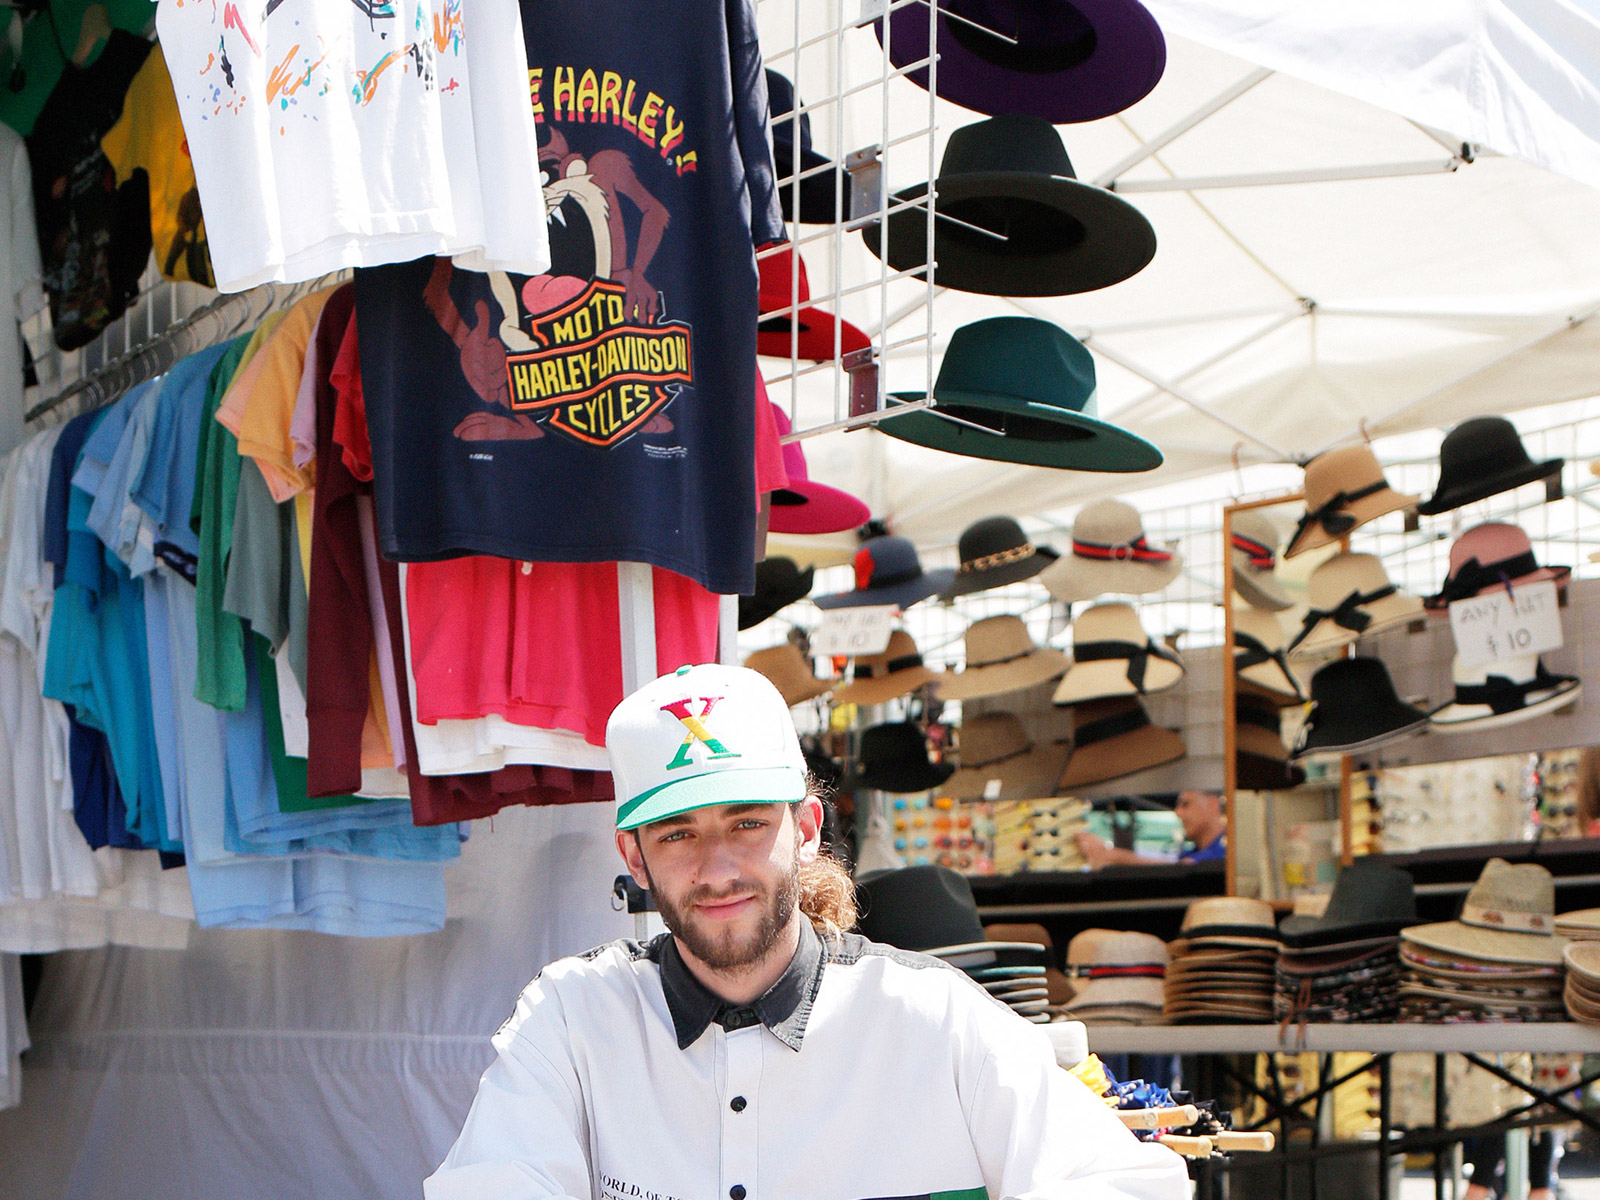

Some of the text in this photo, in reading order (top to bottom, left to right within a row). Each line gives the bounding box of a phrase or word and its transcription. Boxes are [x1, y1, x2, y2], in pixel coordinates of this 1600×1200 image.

[528, 67, 545, 123] E
[553, 292, 639, 344] MOTO
[513, 336, 688, 400] HARLEY-DAVIDSON
[567, 384, 651, 436] CYCLES
[660, 695, 742, 770] X
